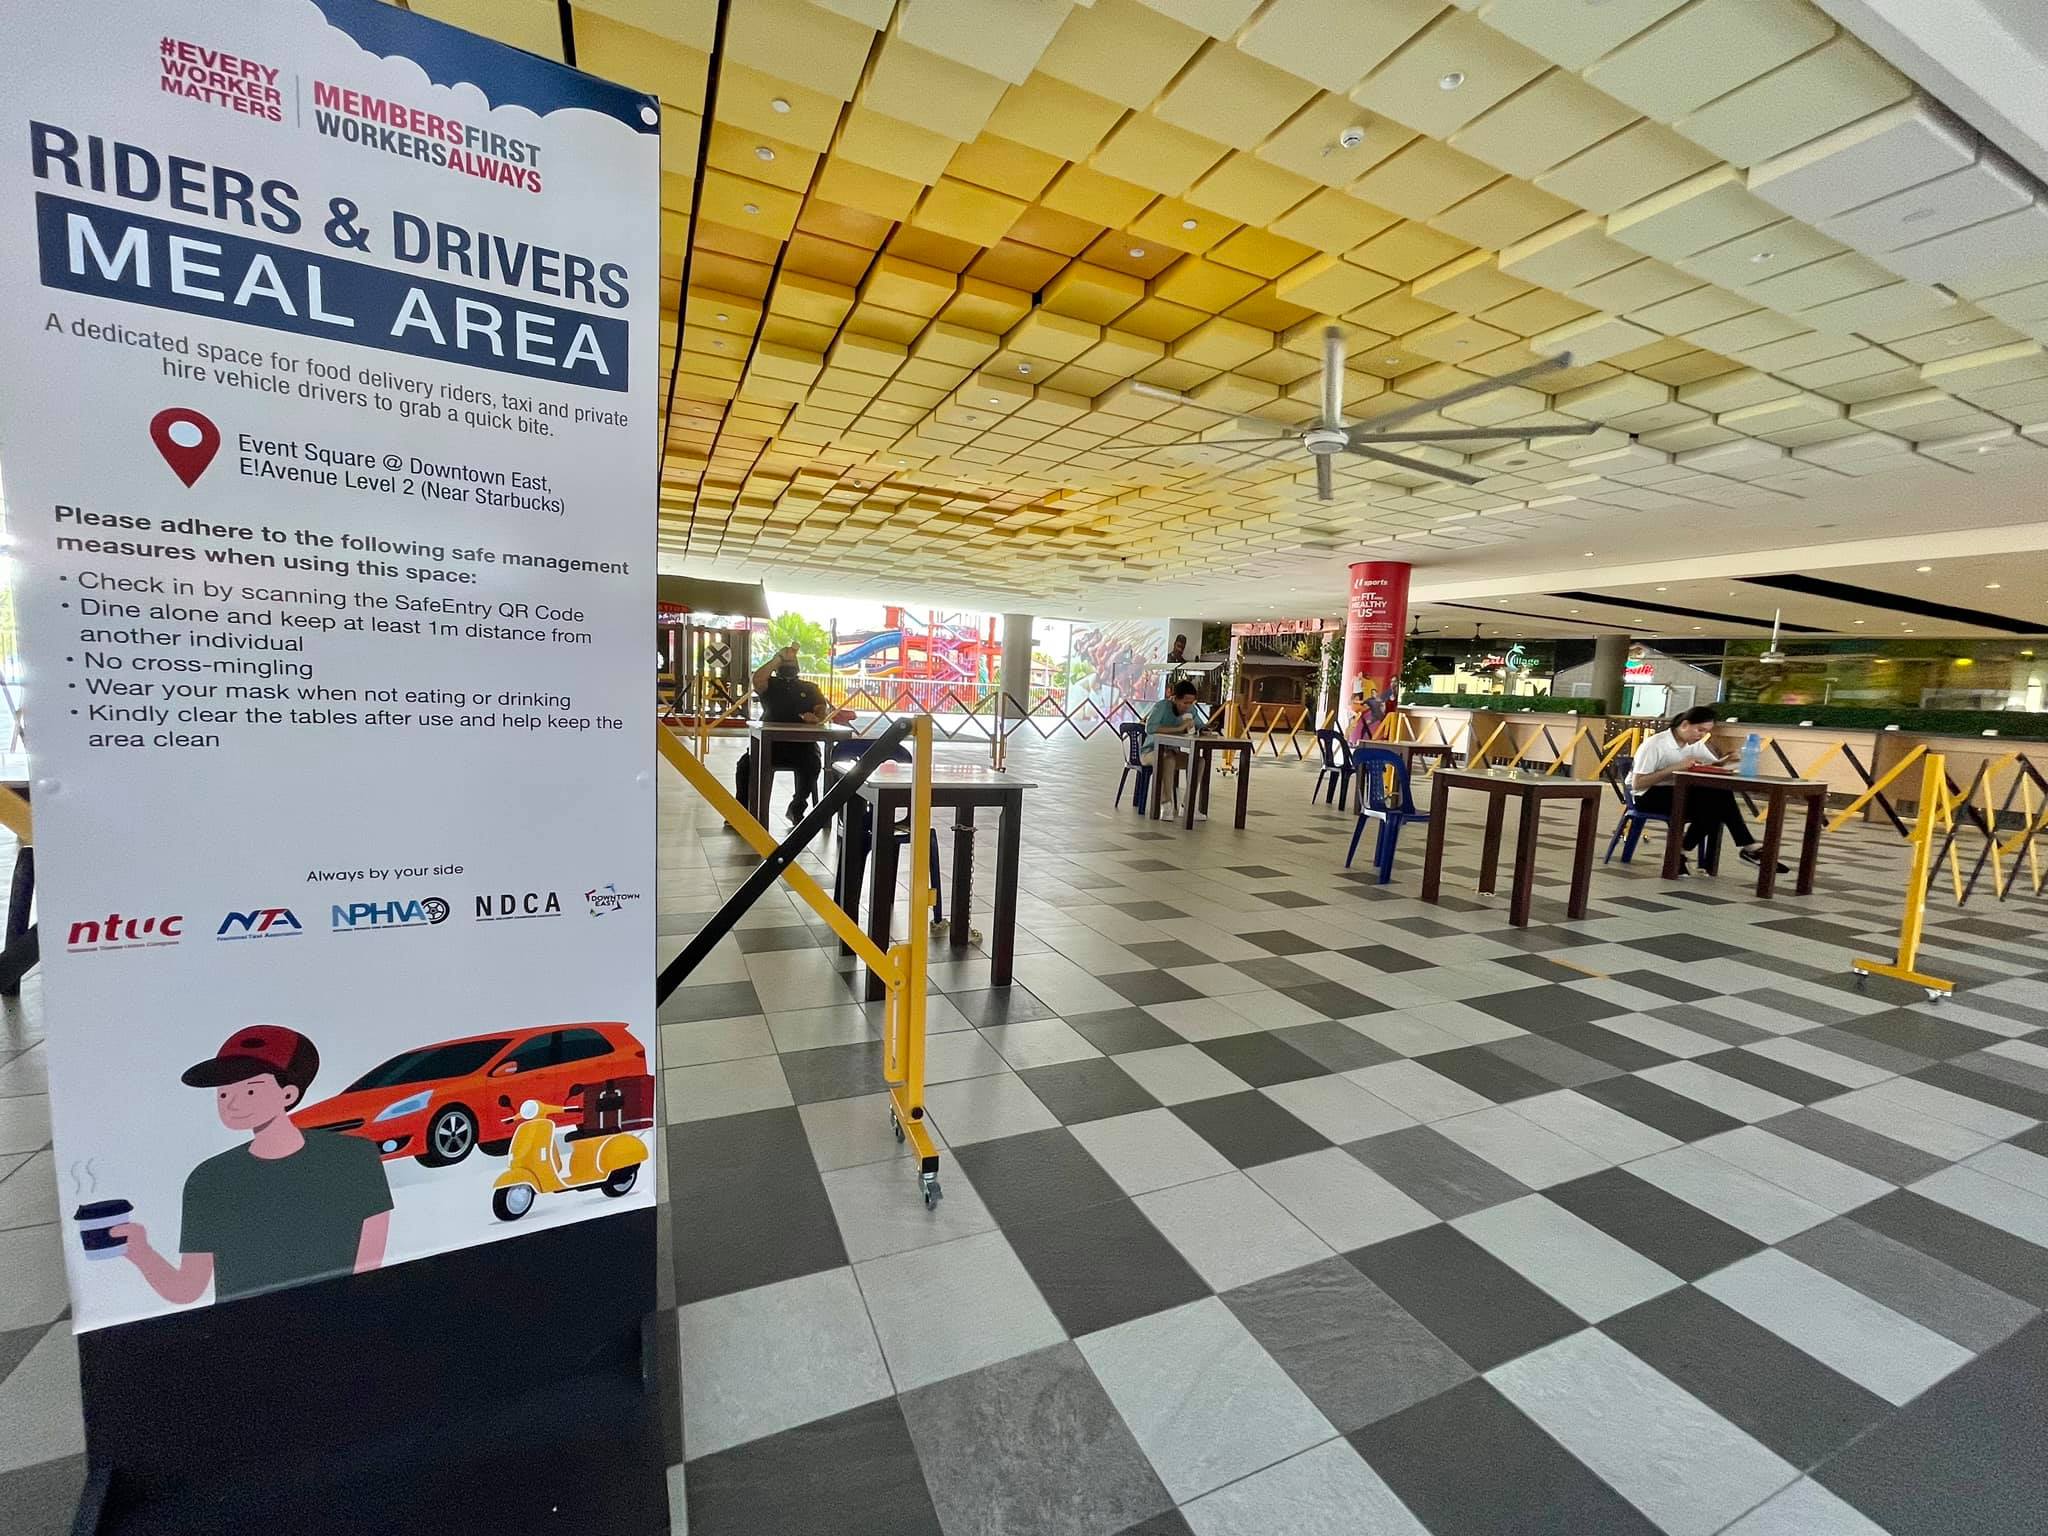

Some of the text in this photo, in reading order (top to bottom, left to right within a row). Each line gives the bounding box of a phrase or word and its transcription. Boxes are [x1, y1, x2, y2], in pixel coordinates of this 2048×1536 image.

[160, 36, 279, 86] #EVERY
[161, 57, 281, 106] WORKER
[161, 76, 282, 122] MATTERS
[314, 81, 542, 168] MEMBERSFIRST
[315, 109, 542, 194] WORKERSALWAYS
[30, 120, 630, 309] RIDERS & DRIVERS
[66, 212, 610, 376] MEAL AREA
[45, 312, 628, 427] A dedicated space for food delivery riders, taxi and private
[163, 357, 553, 437] hire vehicle drivers to grab a quick bite.
[239, 433, 552, 493] Event Square @ Downtown East,
[240, 457, 566, 516] E!Avenue Level 2 (Near Starbucks)
[55, 505, 629, 575] Please adhere to the following safe management
[56, 536, 477, 584] measures when using this space:
[78, 571, 584, 622] Check in by scanning the SafeEntry QR Code
[1358, 608, 1373, 617] US
[1361, 592, 1376, 601] FIT
[80, 628, 304, 652] another individual
[81, 598, 592, 644] Dine alone and keep at least 1m distance from
[85, 651, 313, 680] No cross-mingling
[86, 678, 571, 710] Wear your mask when not eating or drinking
[89, 704, 624, 732] Kindly clear the tables after use and help keep the
[89, 730, 220, 748] area clean
[306, 864, 464, 882] Always by your side
[217, 907, 303, 935] NTA
[332, 899, 427, 927] NPHVA
[475, 892, 561, 917] NDCA
[591, 893, 640, 903] DOWNTOWN
[595, 899, 615, 907] EAST
[68, 913, 183, 945] ntuc
